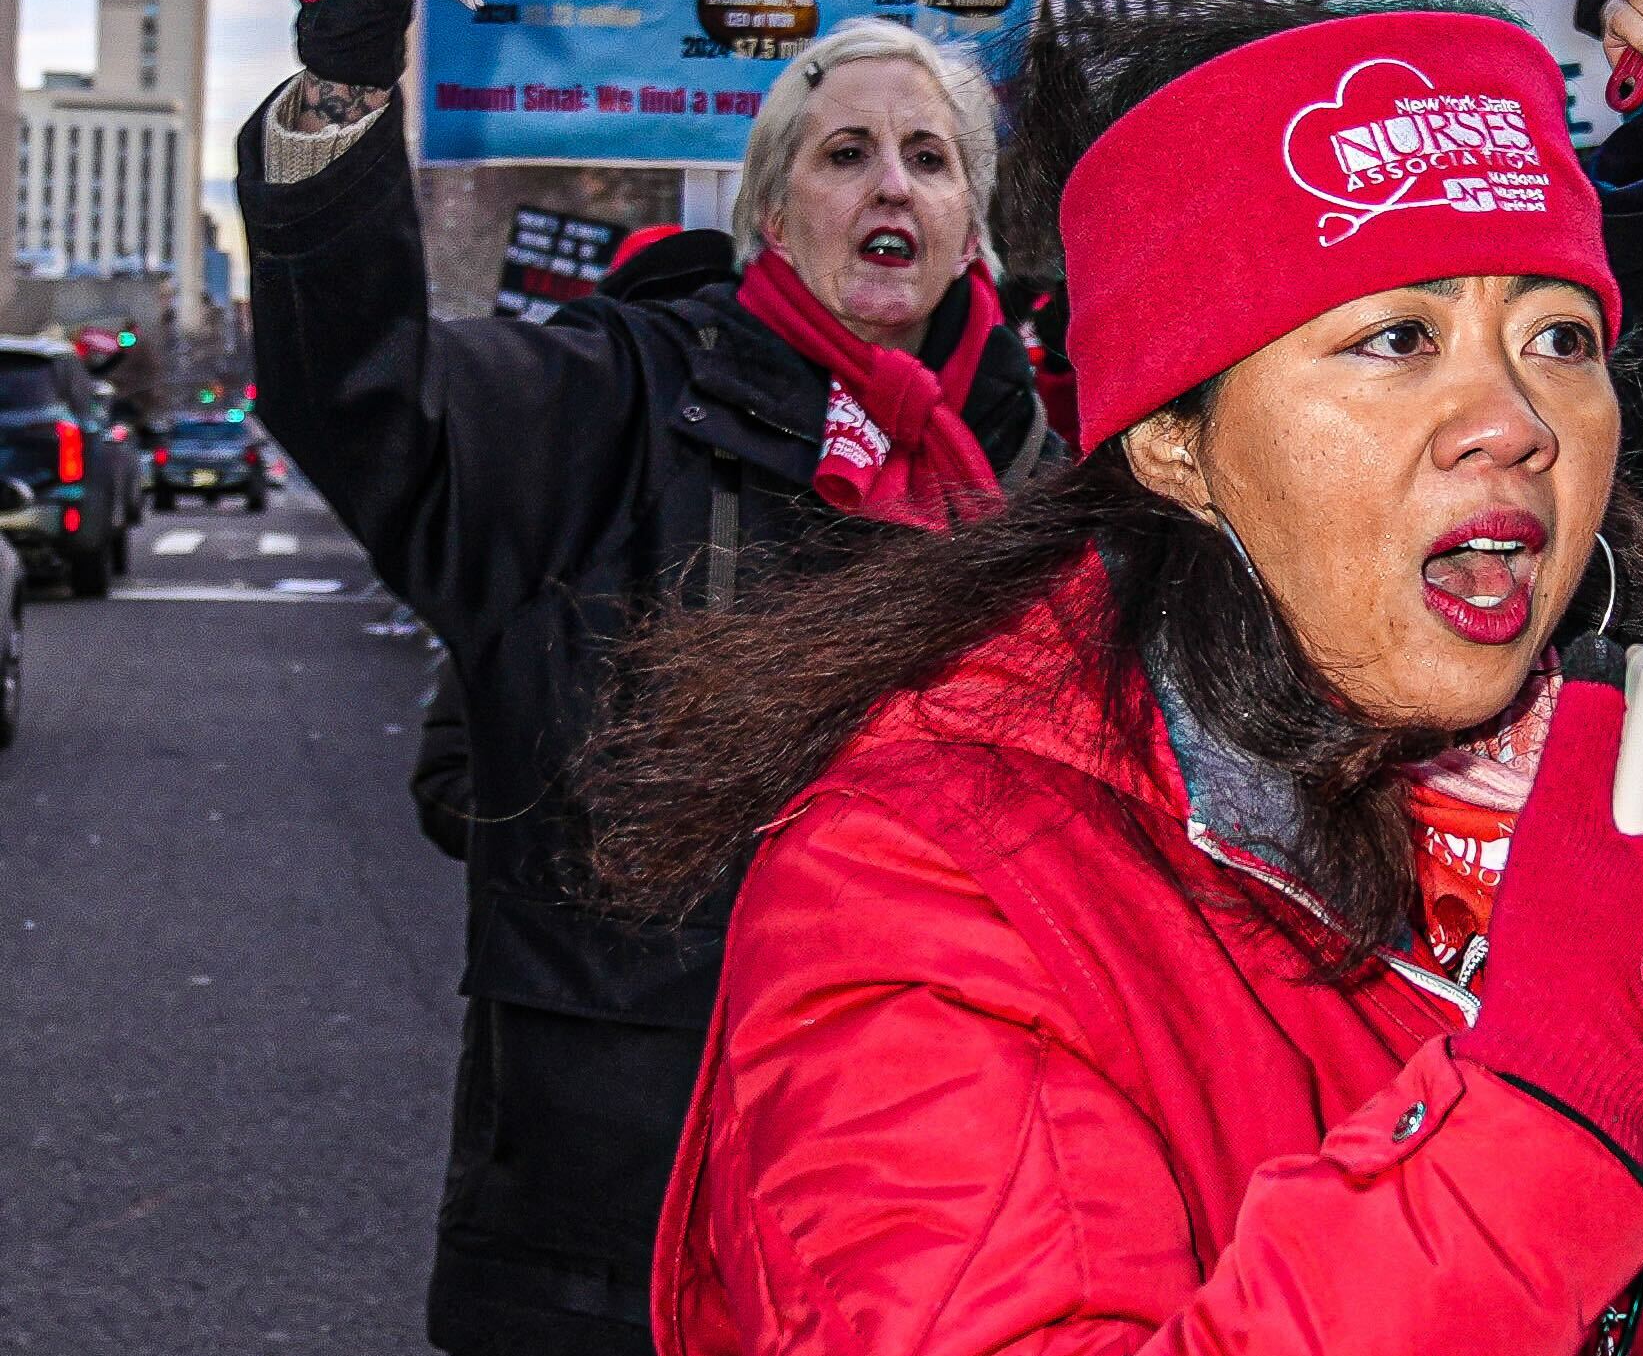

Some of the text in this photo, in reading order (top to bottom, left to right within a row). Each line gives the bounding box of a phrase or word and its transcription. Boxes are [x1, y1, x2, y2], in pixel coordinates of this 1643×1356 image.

[436, 83, 517, 112] Mount
[596, 86, 634, 114] We
[639, 85, 687, 114] find
[693, 90, 708, 114] a
[1394, 95, 1522, 114] New York State
[1330, 112, 1537, 175] NURSES
